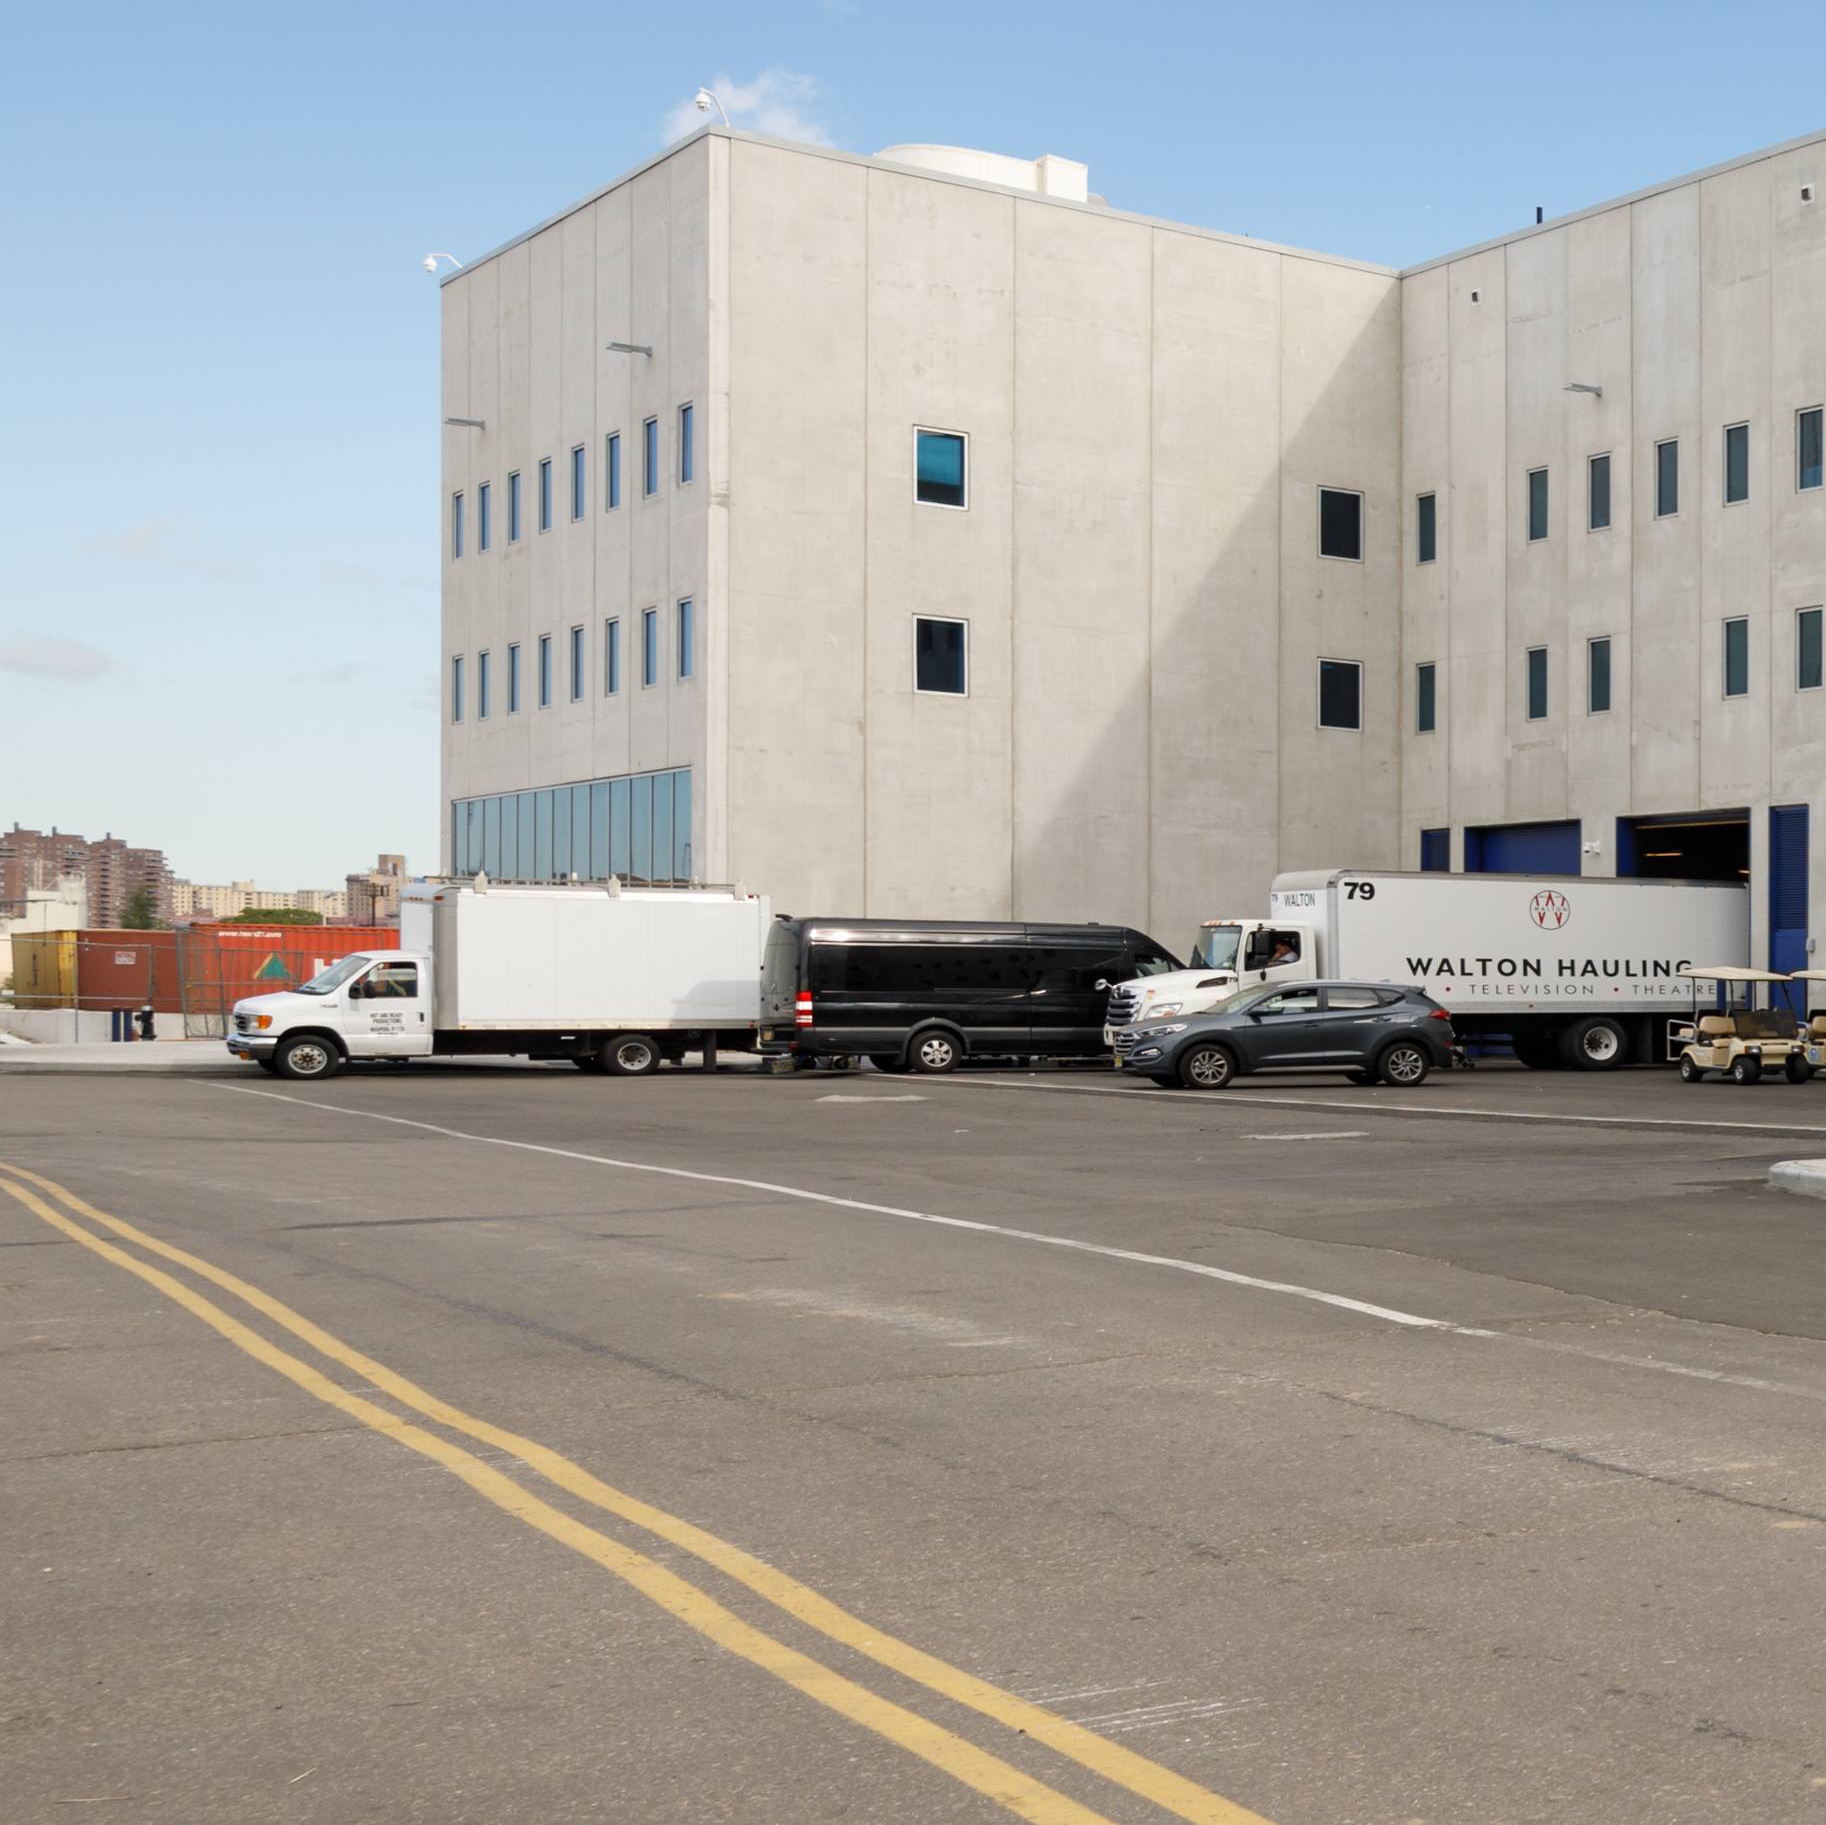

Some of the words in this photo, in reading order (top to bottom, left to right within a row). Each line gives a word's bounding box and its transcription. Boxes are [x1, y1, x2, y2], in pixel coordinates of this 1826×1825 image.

[1343, 881, 1375, 901] 79
[1283, 893, 1315, 907] WALTON
[1405, 957, 1542, 977] WALTON
[1469, 984, 1594, 995] TELEVISION
[1632, 984, 1716, 995] THEATRE
